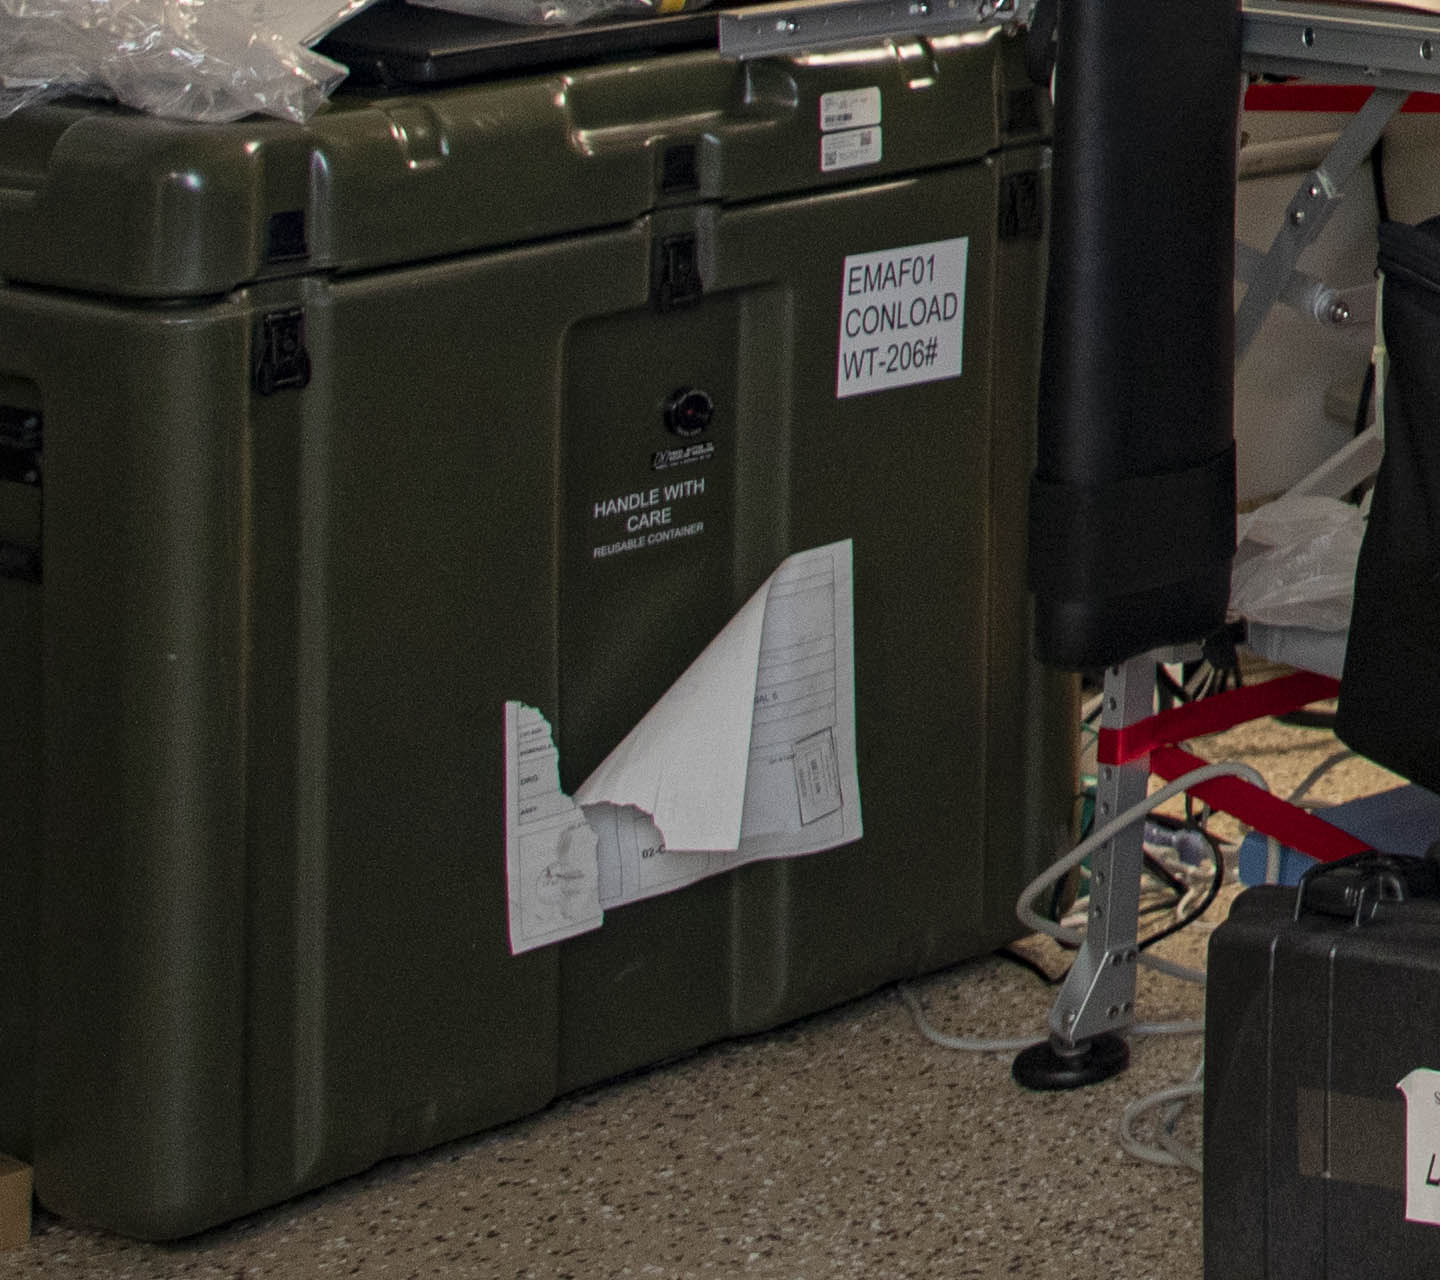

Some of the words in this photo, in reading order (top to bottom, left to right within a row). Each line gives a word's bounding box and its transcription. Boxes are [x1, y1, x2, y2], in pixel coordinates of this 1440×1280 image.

[848, 253, 936, 297] EMAF01
[844, 291, 959, 338] CONLOAD
[843, 335, 939, 382] WT-206#
[593, 487, 661, 519] HANDLE
[663, 477, 706, 502] WITH
[626, 506, 672, 533] CARE
[592, 534, 646, 559] REUSABLE
[647, 521, 705, 545] CONTAINER
